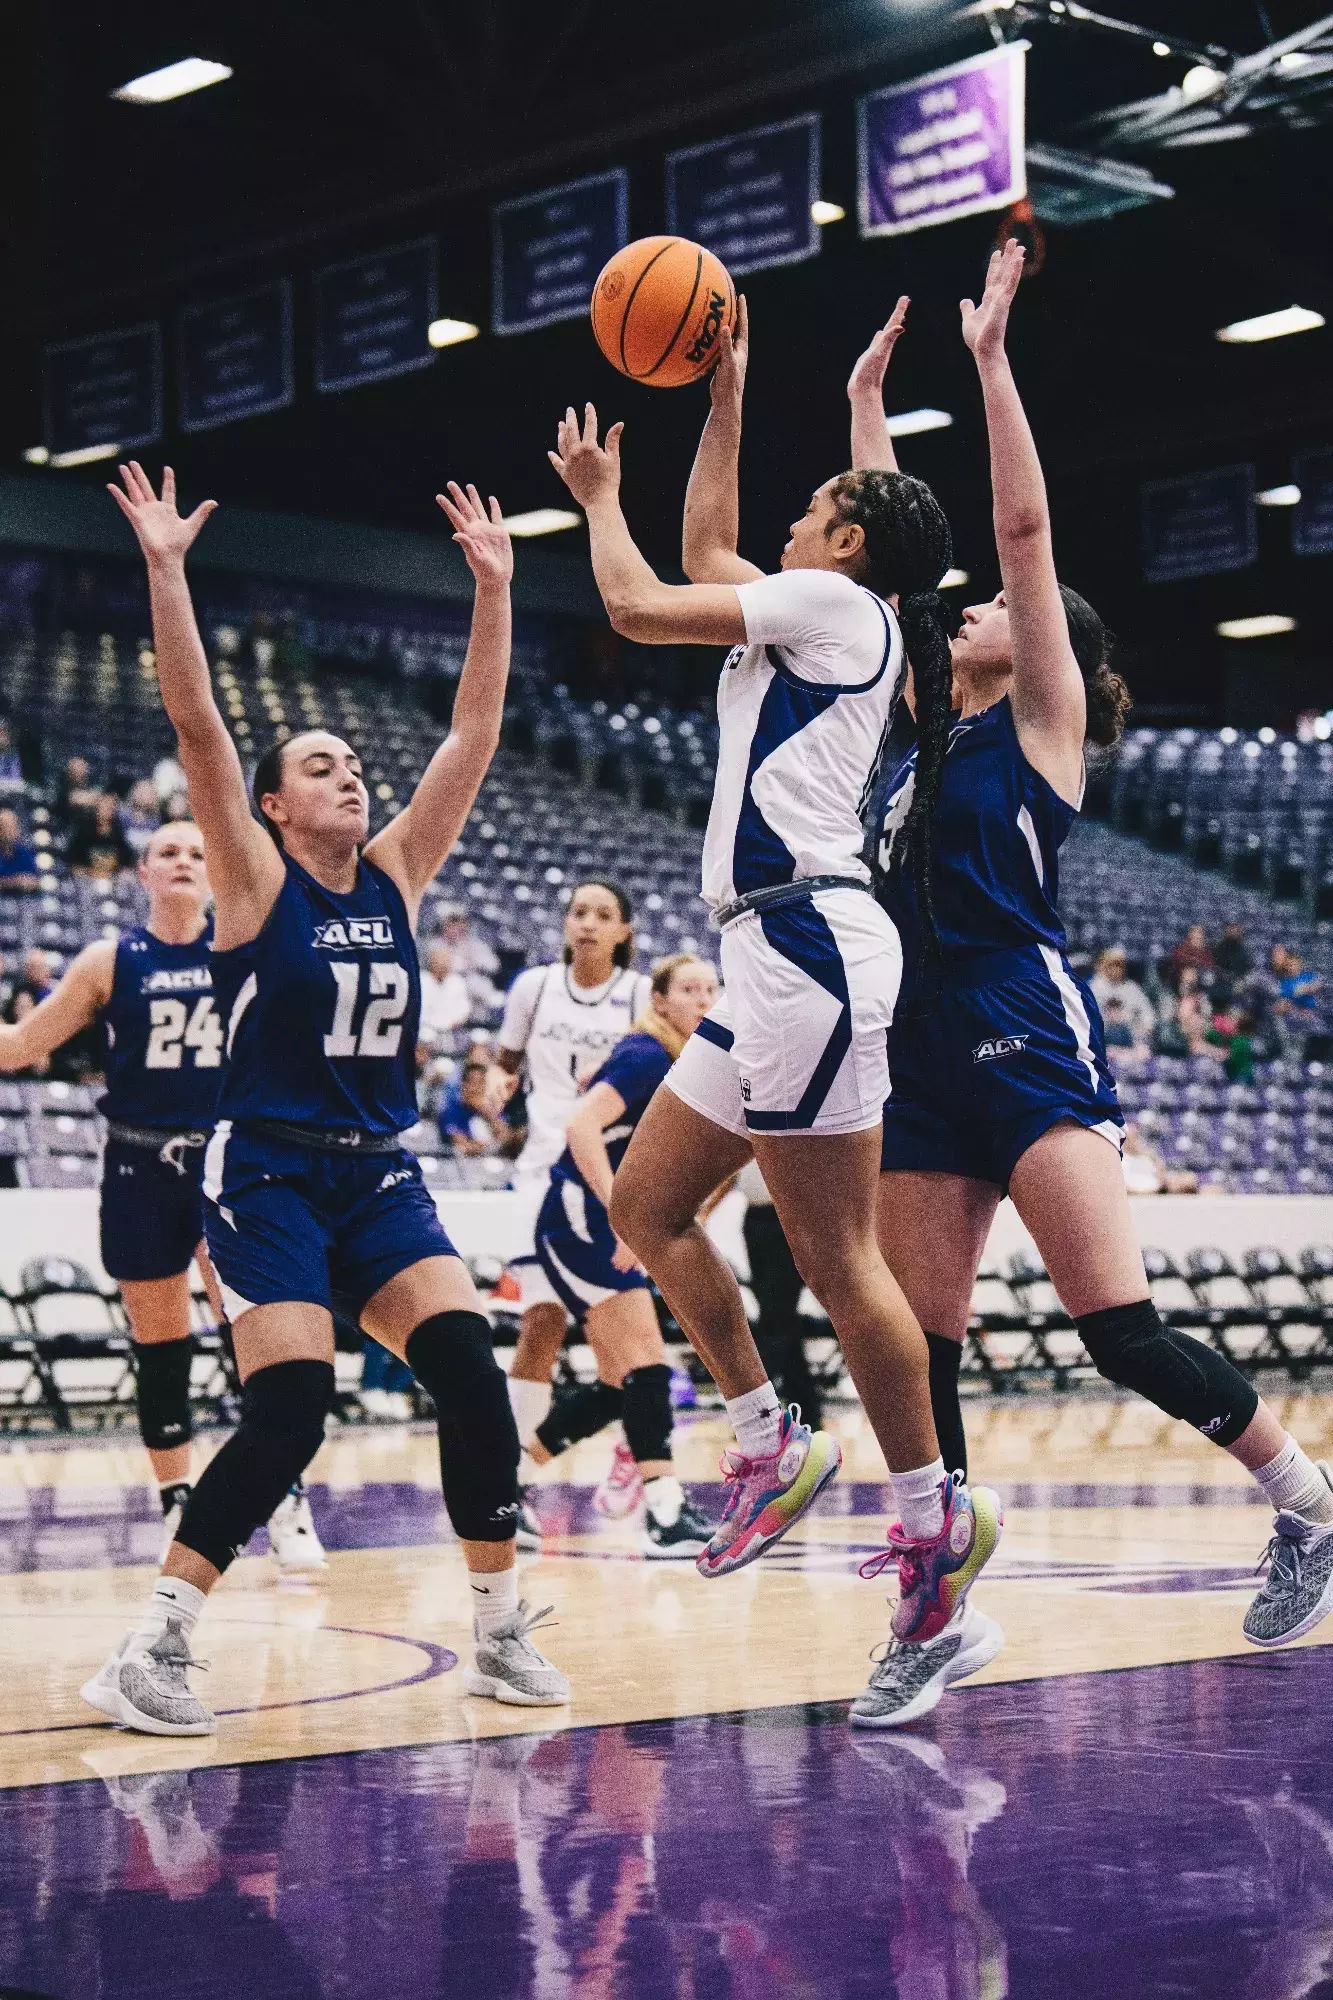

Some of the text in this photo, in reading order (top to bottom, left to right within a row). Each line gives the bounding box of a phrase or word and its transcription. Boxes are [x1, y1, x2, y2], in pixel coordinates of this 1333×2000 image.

[685, 290, 726, 362] NCAA
[319, 919, 394, 947] ACU
[147, 966, 213, 991] ACU
[145, 996, 224, 1069] 24
[323, 961, 409, 1057] 12
[976, 1038, 1024, 1060] ACU
